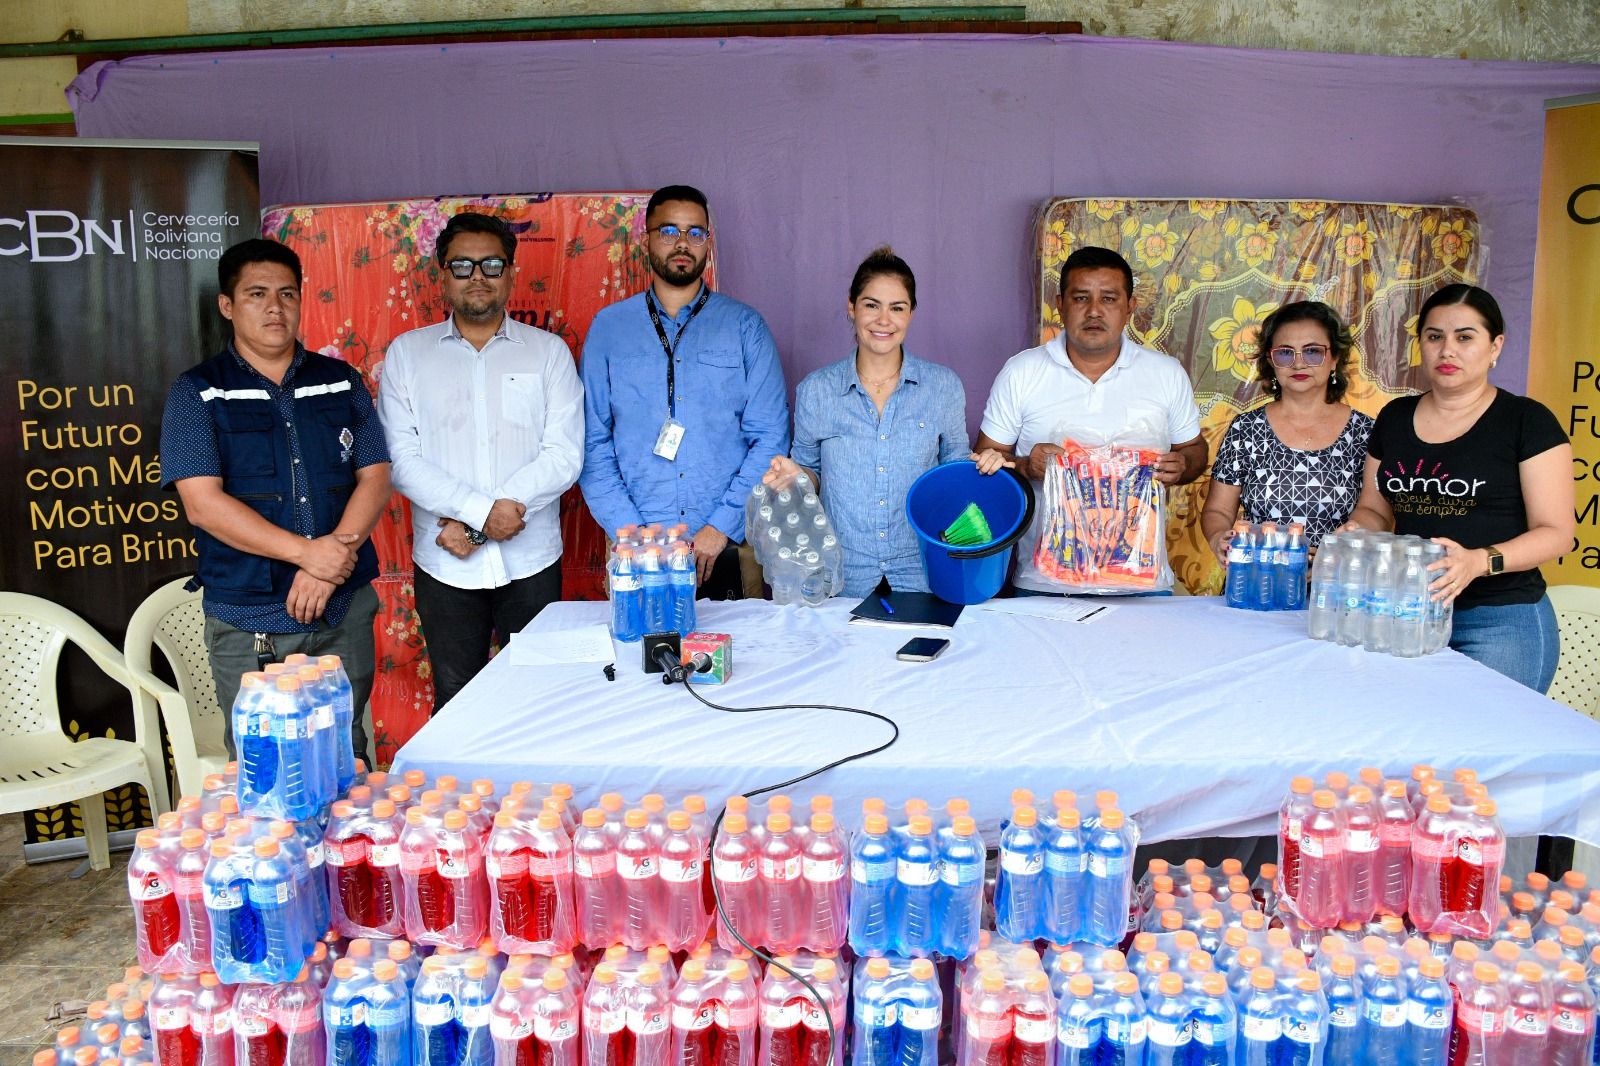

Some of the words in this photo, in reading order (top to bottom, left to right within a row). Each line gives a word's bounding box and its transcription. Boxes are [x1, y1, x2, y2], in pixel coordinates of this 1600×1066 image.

[142, 211, 239, 226] Cervecería
[144, 229, 221, 243] Boliviana
[146, 246, 224, 260] Nacional
[17, 380, 77, 410] Por
[88, 384, 134, 407] un
[21, 420, 142, 450] Futuro
[26, 464, 99, 491] con
[109, 454, 161, 486] Má
[1386, 477, 1486, 497] amor
[30, 496, 179, 531] Motivos
[34, 540, 112, 570] Para
[121, 532, 199, 563] Brin
[150, 878, 159, 887] G
